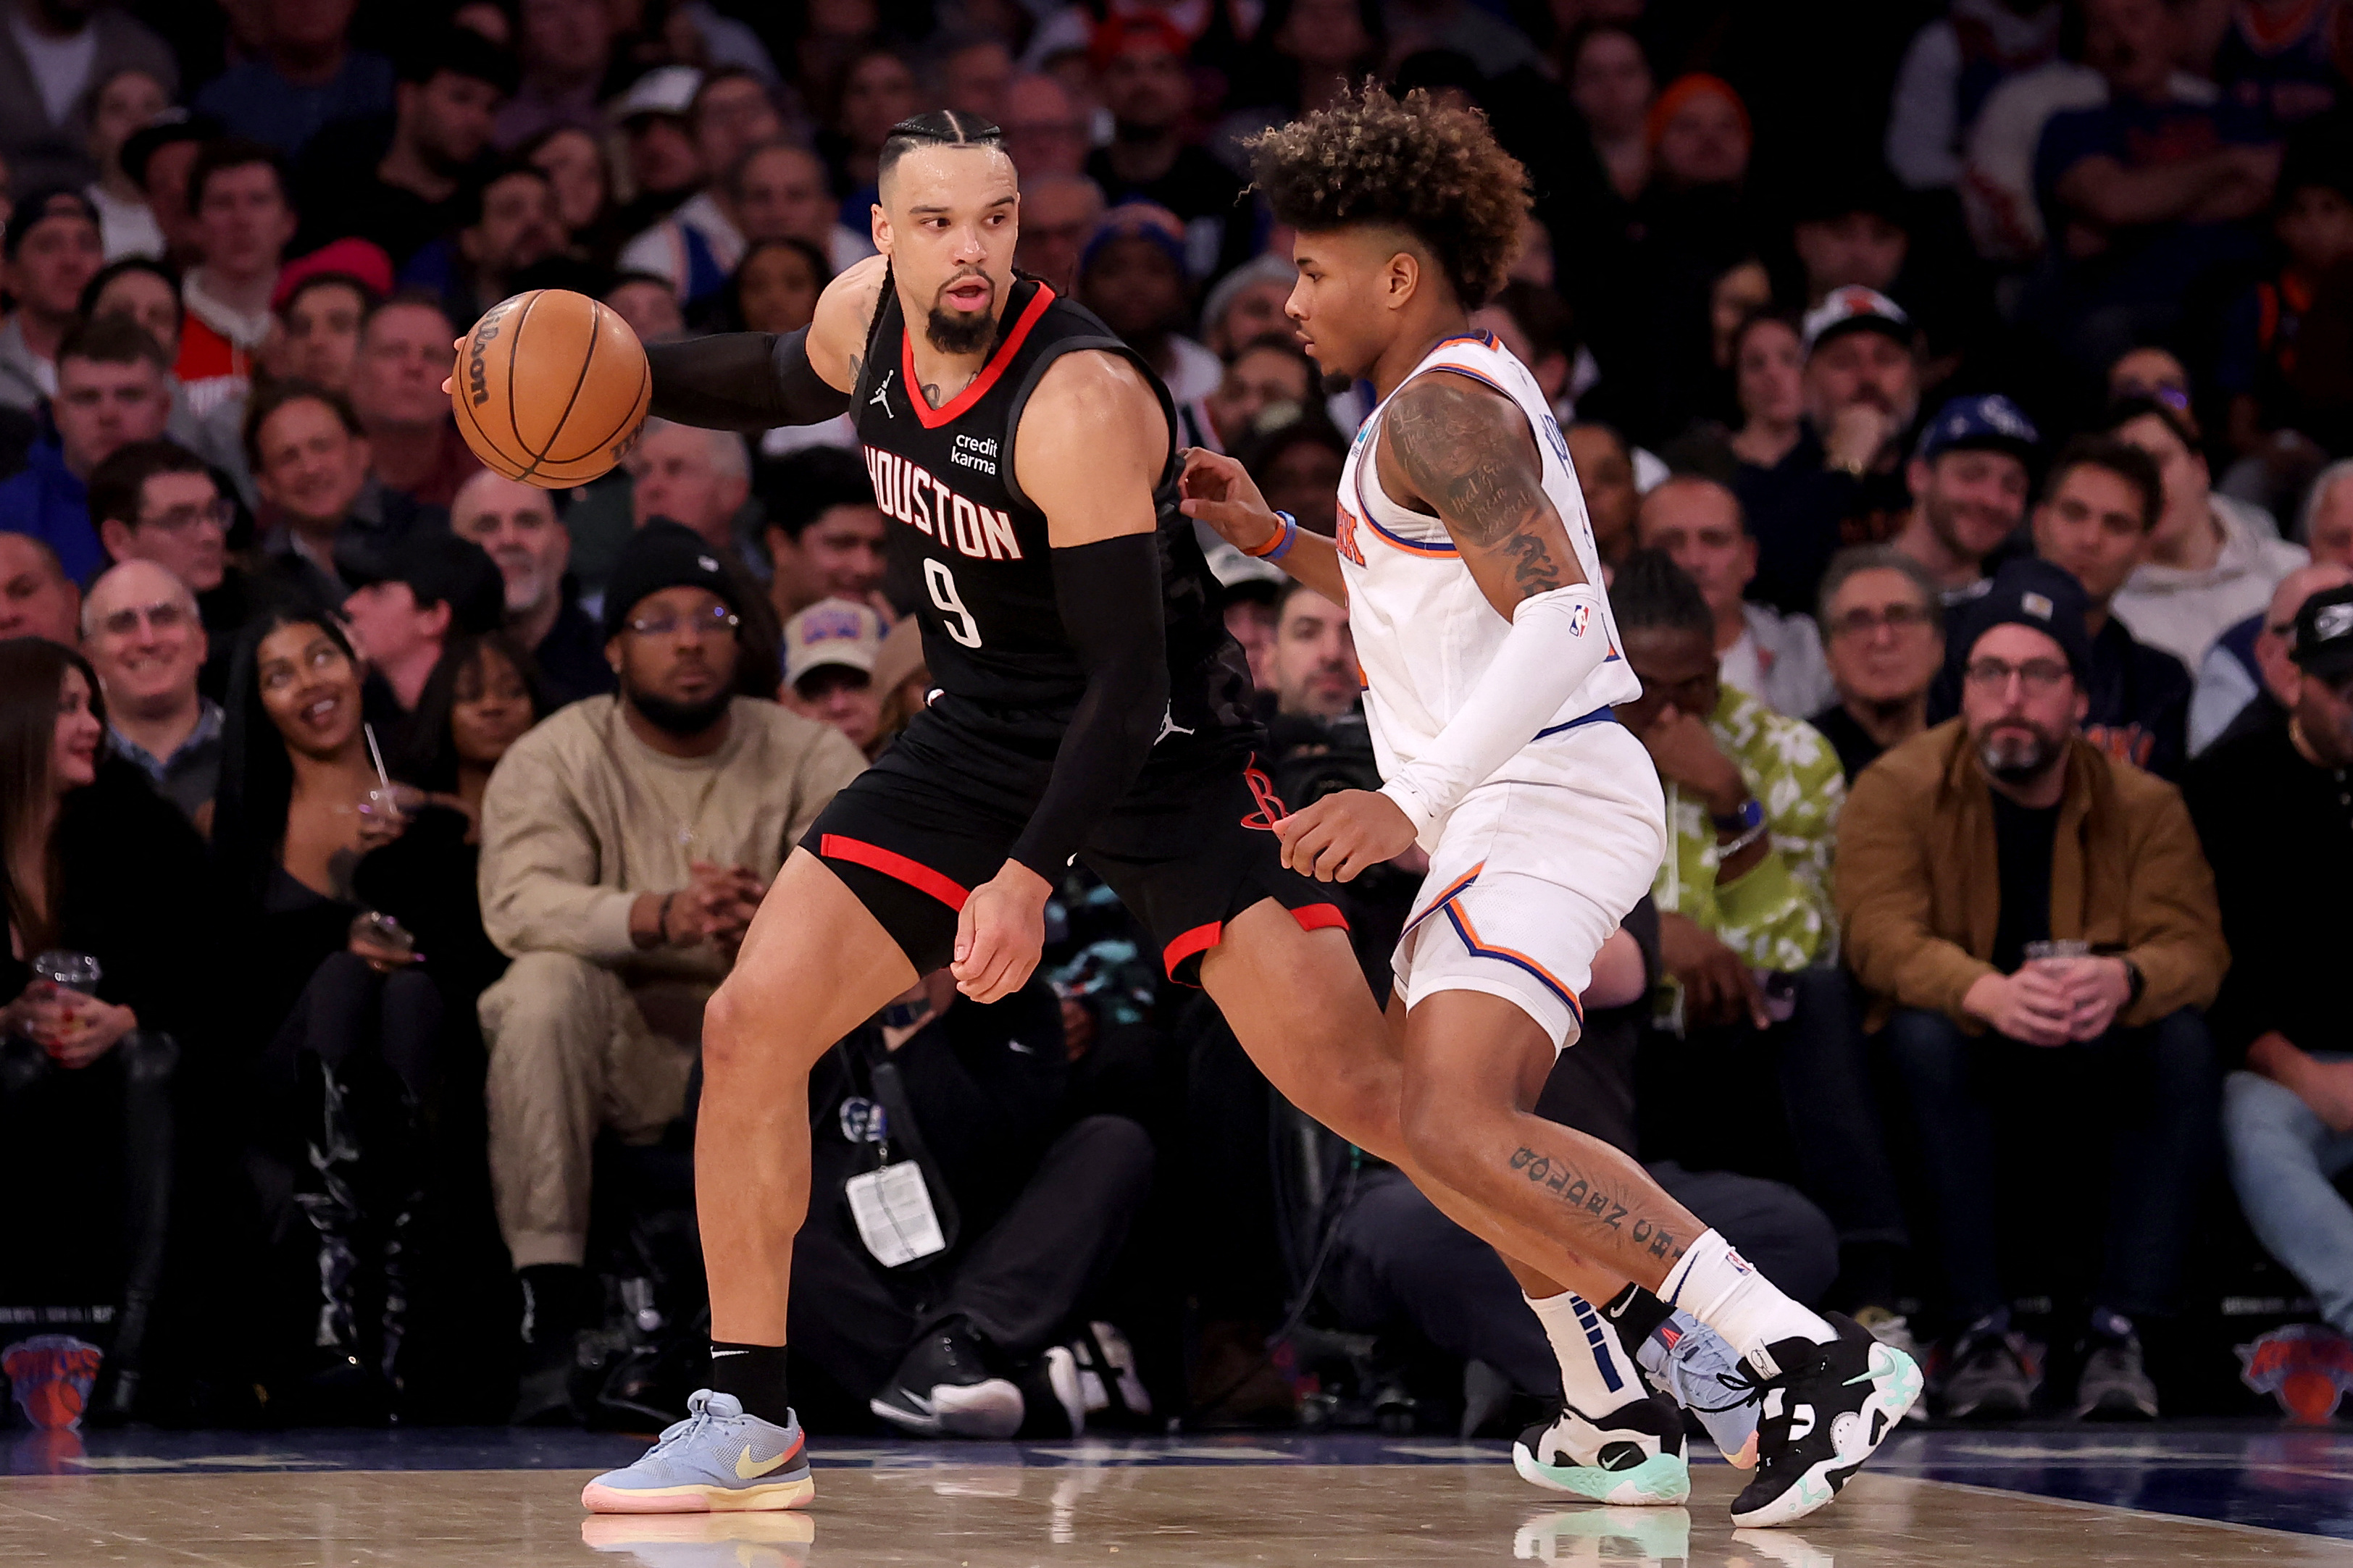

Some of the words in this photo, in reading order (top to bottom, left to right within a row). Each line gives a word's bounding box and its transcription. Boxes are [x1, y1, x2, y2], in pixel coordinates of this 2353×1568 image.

[950, 445, 997, 476] karma
[955, 434, 998, 458] credit
[863, 444, 1023, 561] HOUSTON
[922, 556, 983, 650] 9
